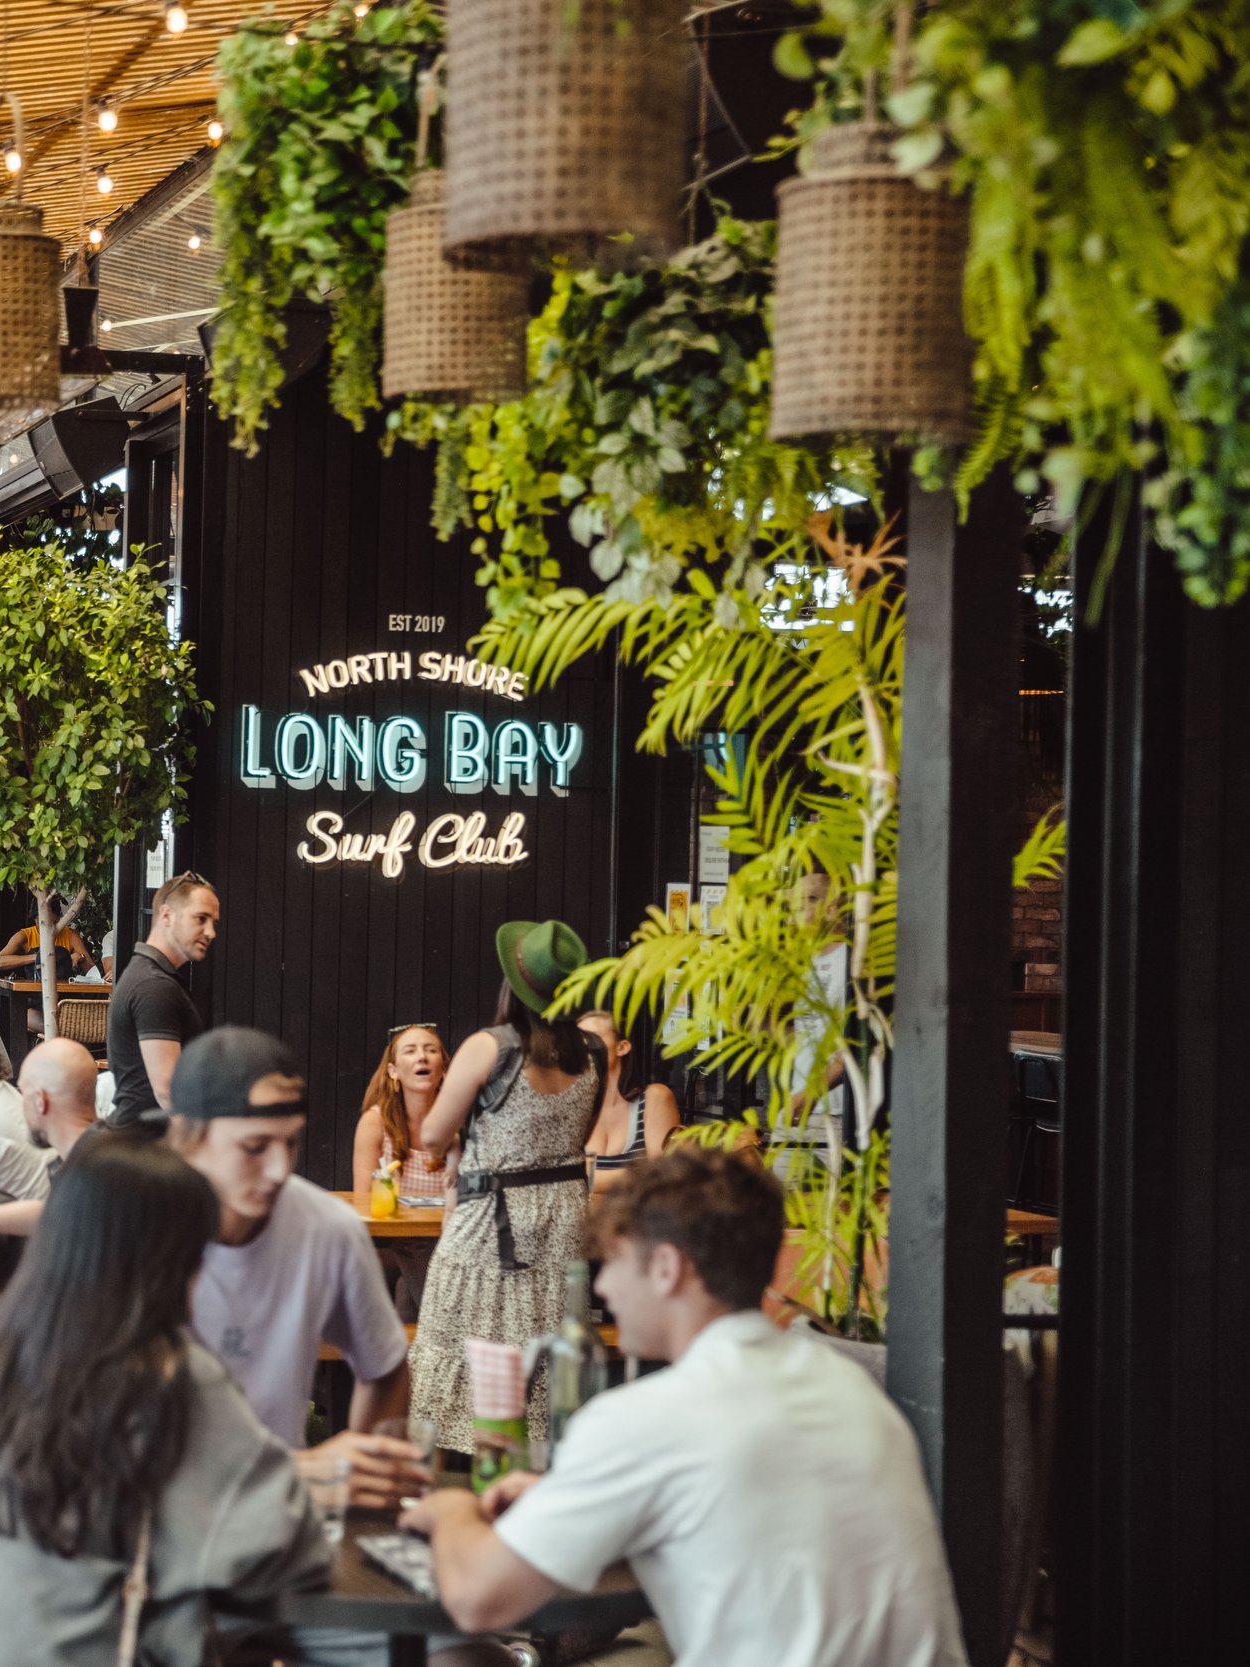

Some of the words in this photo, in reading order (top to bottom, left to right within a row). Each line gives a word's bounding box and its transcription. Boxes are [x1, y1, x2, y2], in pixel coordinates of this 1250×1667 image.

[388, 614, 413, 632] EST
[414, 615, 446, 633] 2019
[299, 651, 412, 698] NORTH
[417, 651, 530, 702] SHORE
[240, 704, 427, 793] LONG
[443, 711, 582, 798] BAY
[297, 810, 417, 878] Surf
[419, 810, 530, 869] Club
